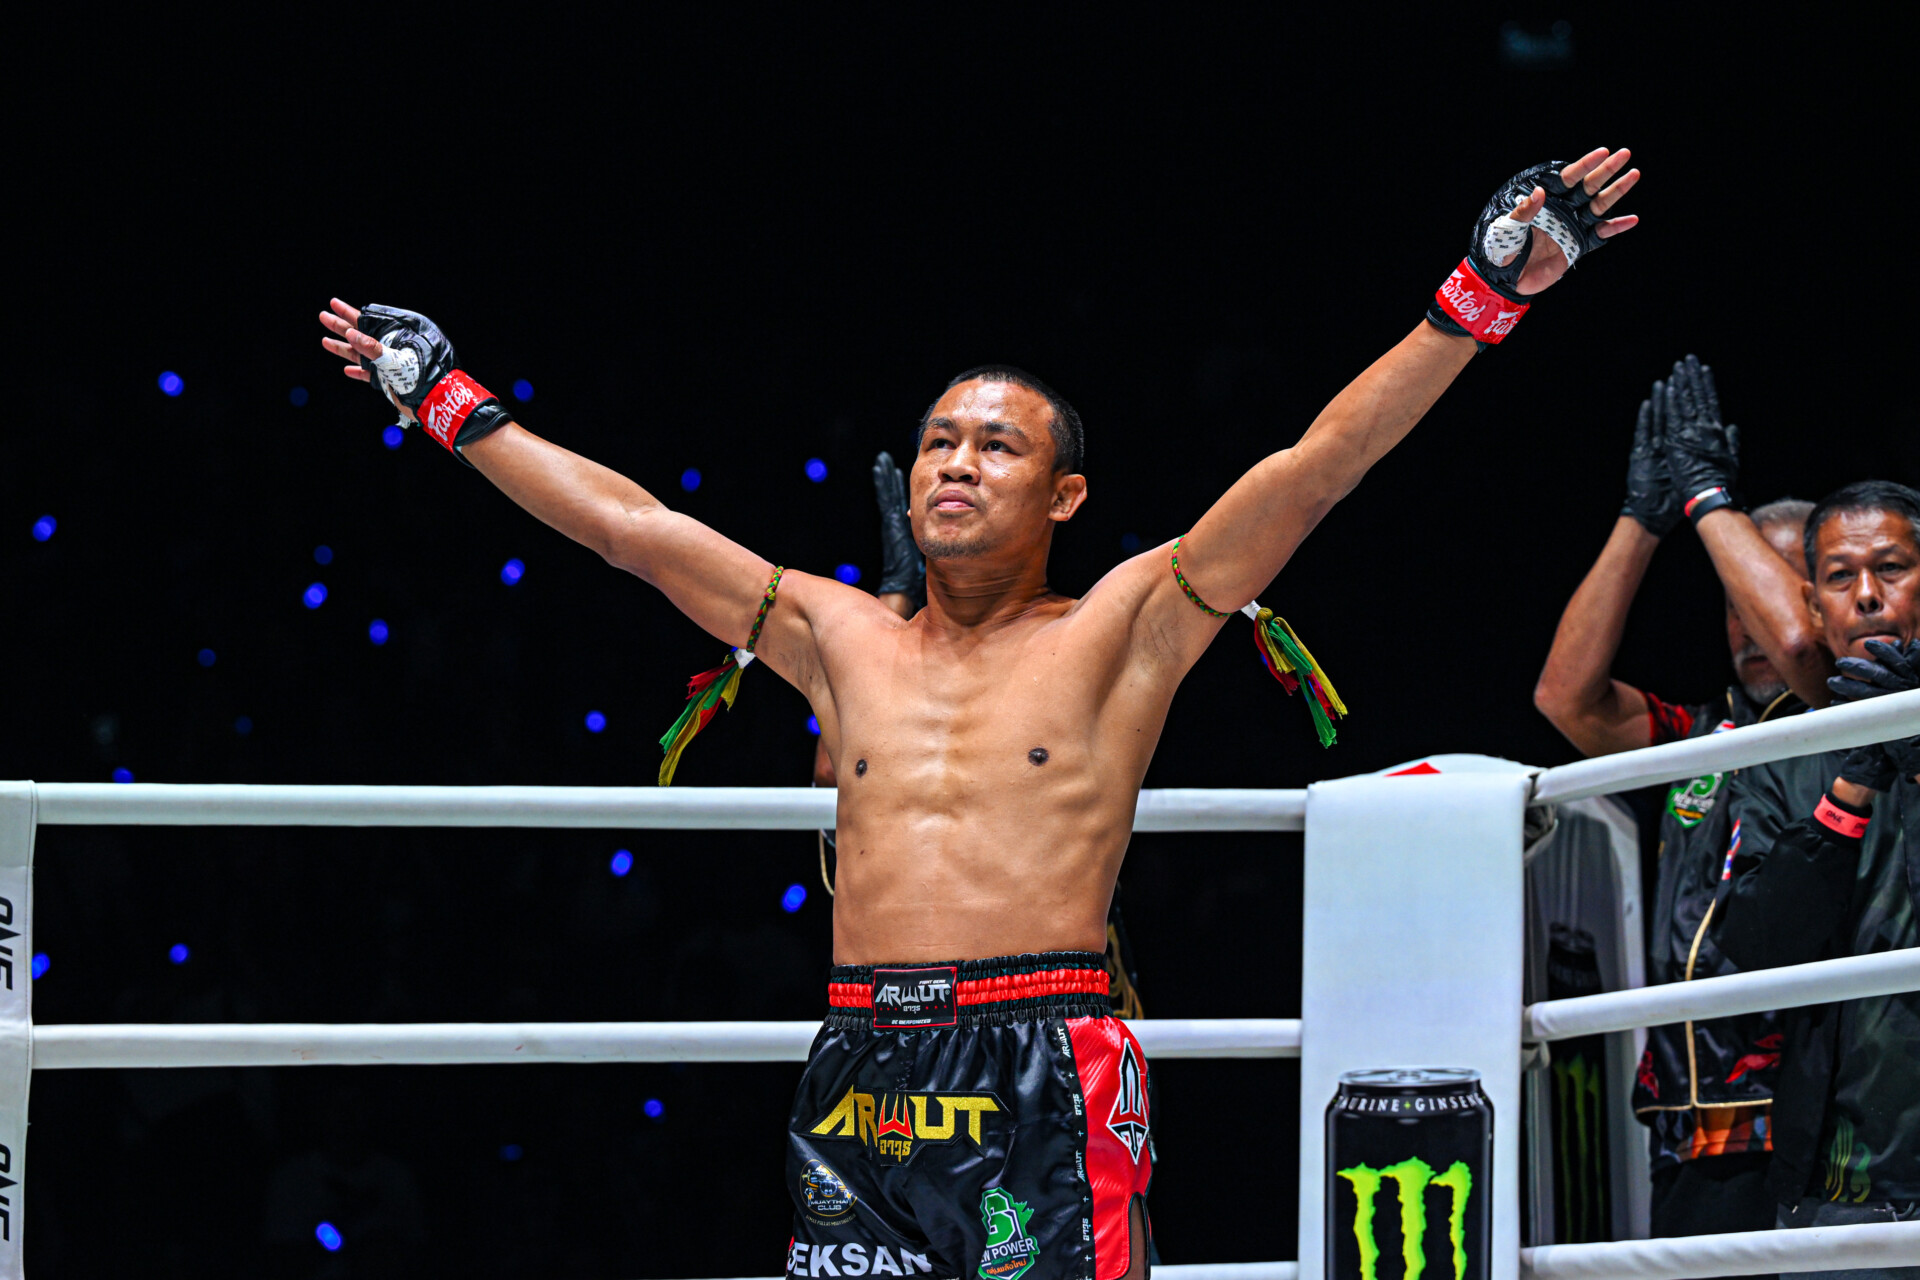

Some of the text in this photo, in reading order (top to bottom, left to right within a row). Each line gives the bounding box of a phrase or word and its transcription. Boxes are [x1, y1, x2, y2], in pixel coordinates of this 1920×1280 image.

[427, 381, 474, 442] Fairtex
[875, 983, 951, 1006] ARWUT
[810, 1085, 1000, 1148] ARWUT
[991, 1237, 1036, 1259] POWER
